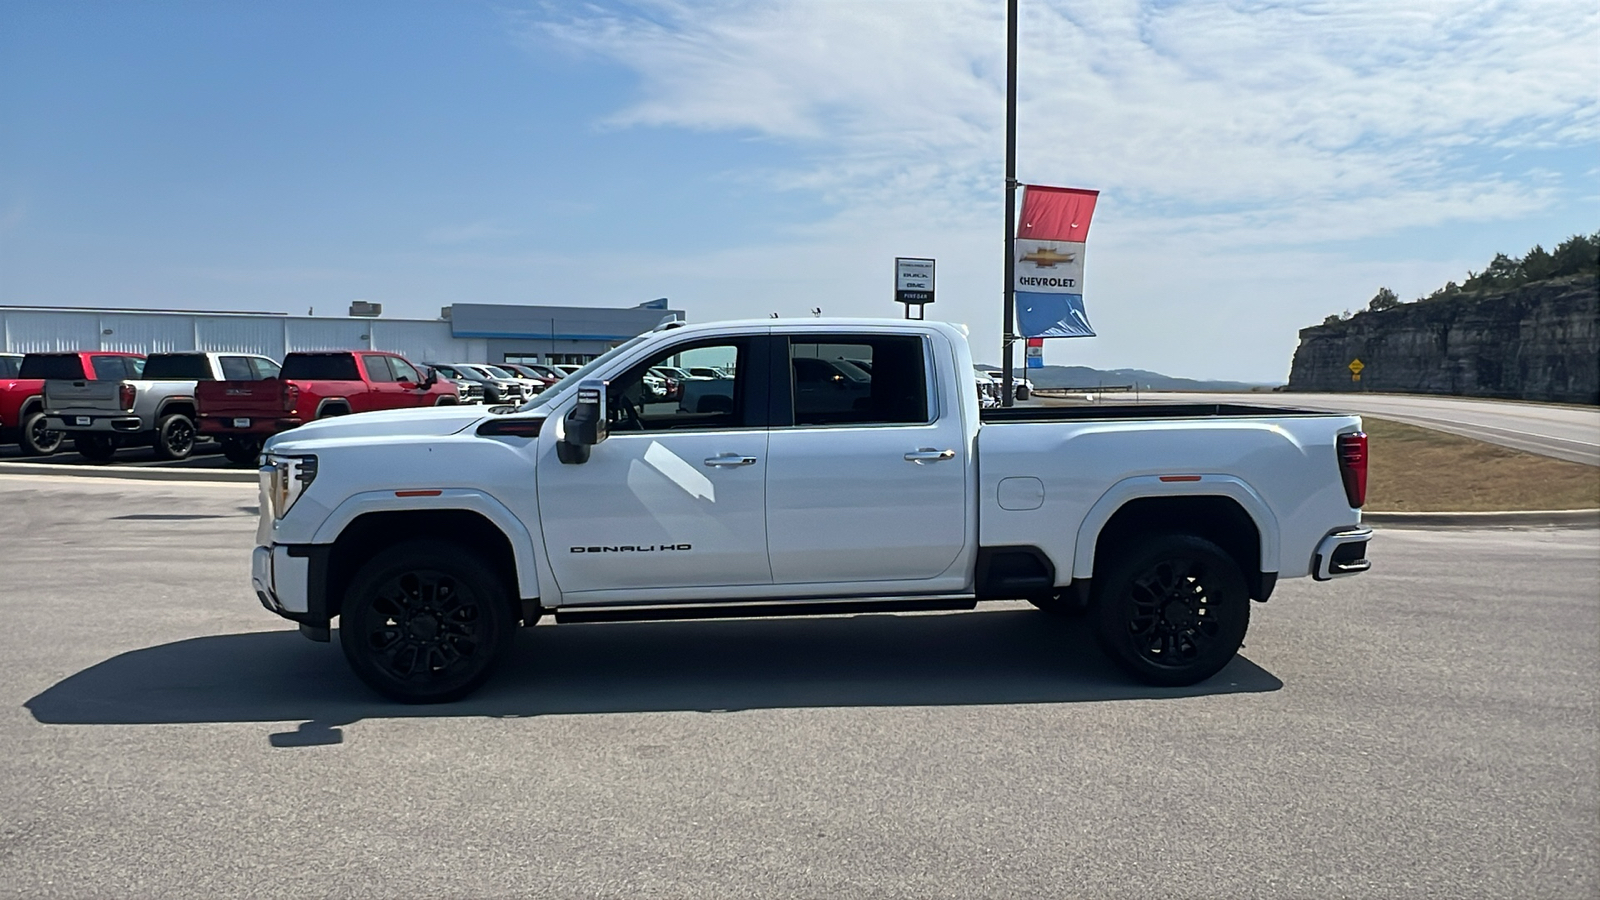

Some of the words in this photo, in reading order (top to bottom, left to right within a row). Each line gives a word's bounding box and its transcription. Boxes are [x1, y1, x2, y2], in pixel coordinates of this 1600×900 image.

[1019, 276, 1075, 288] CHEVROLET
[570, 545, 655, 553] DENALI
[660, 544, 692, 552] HD
